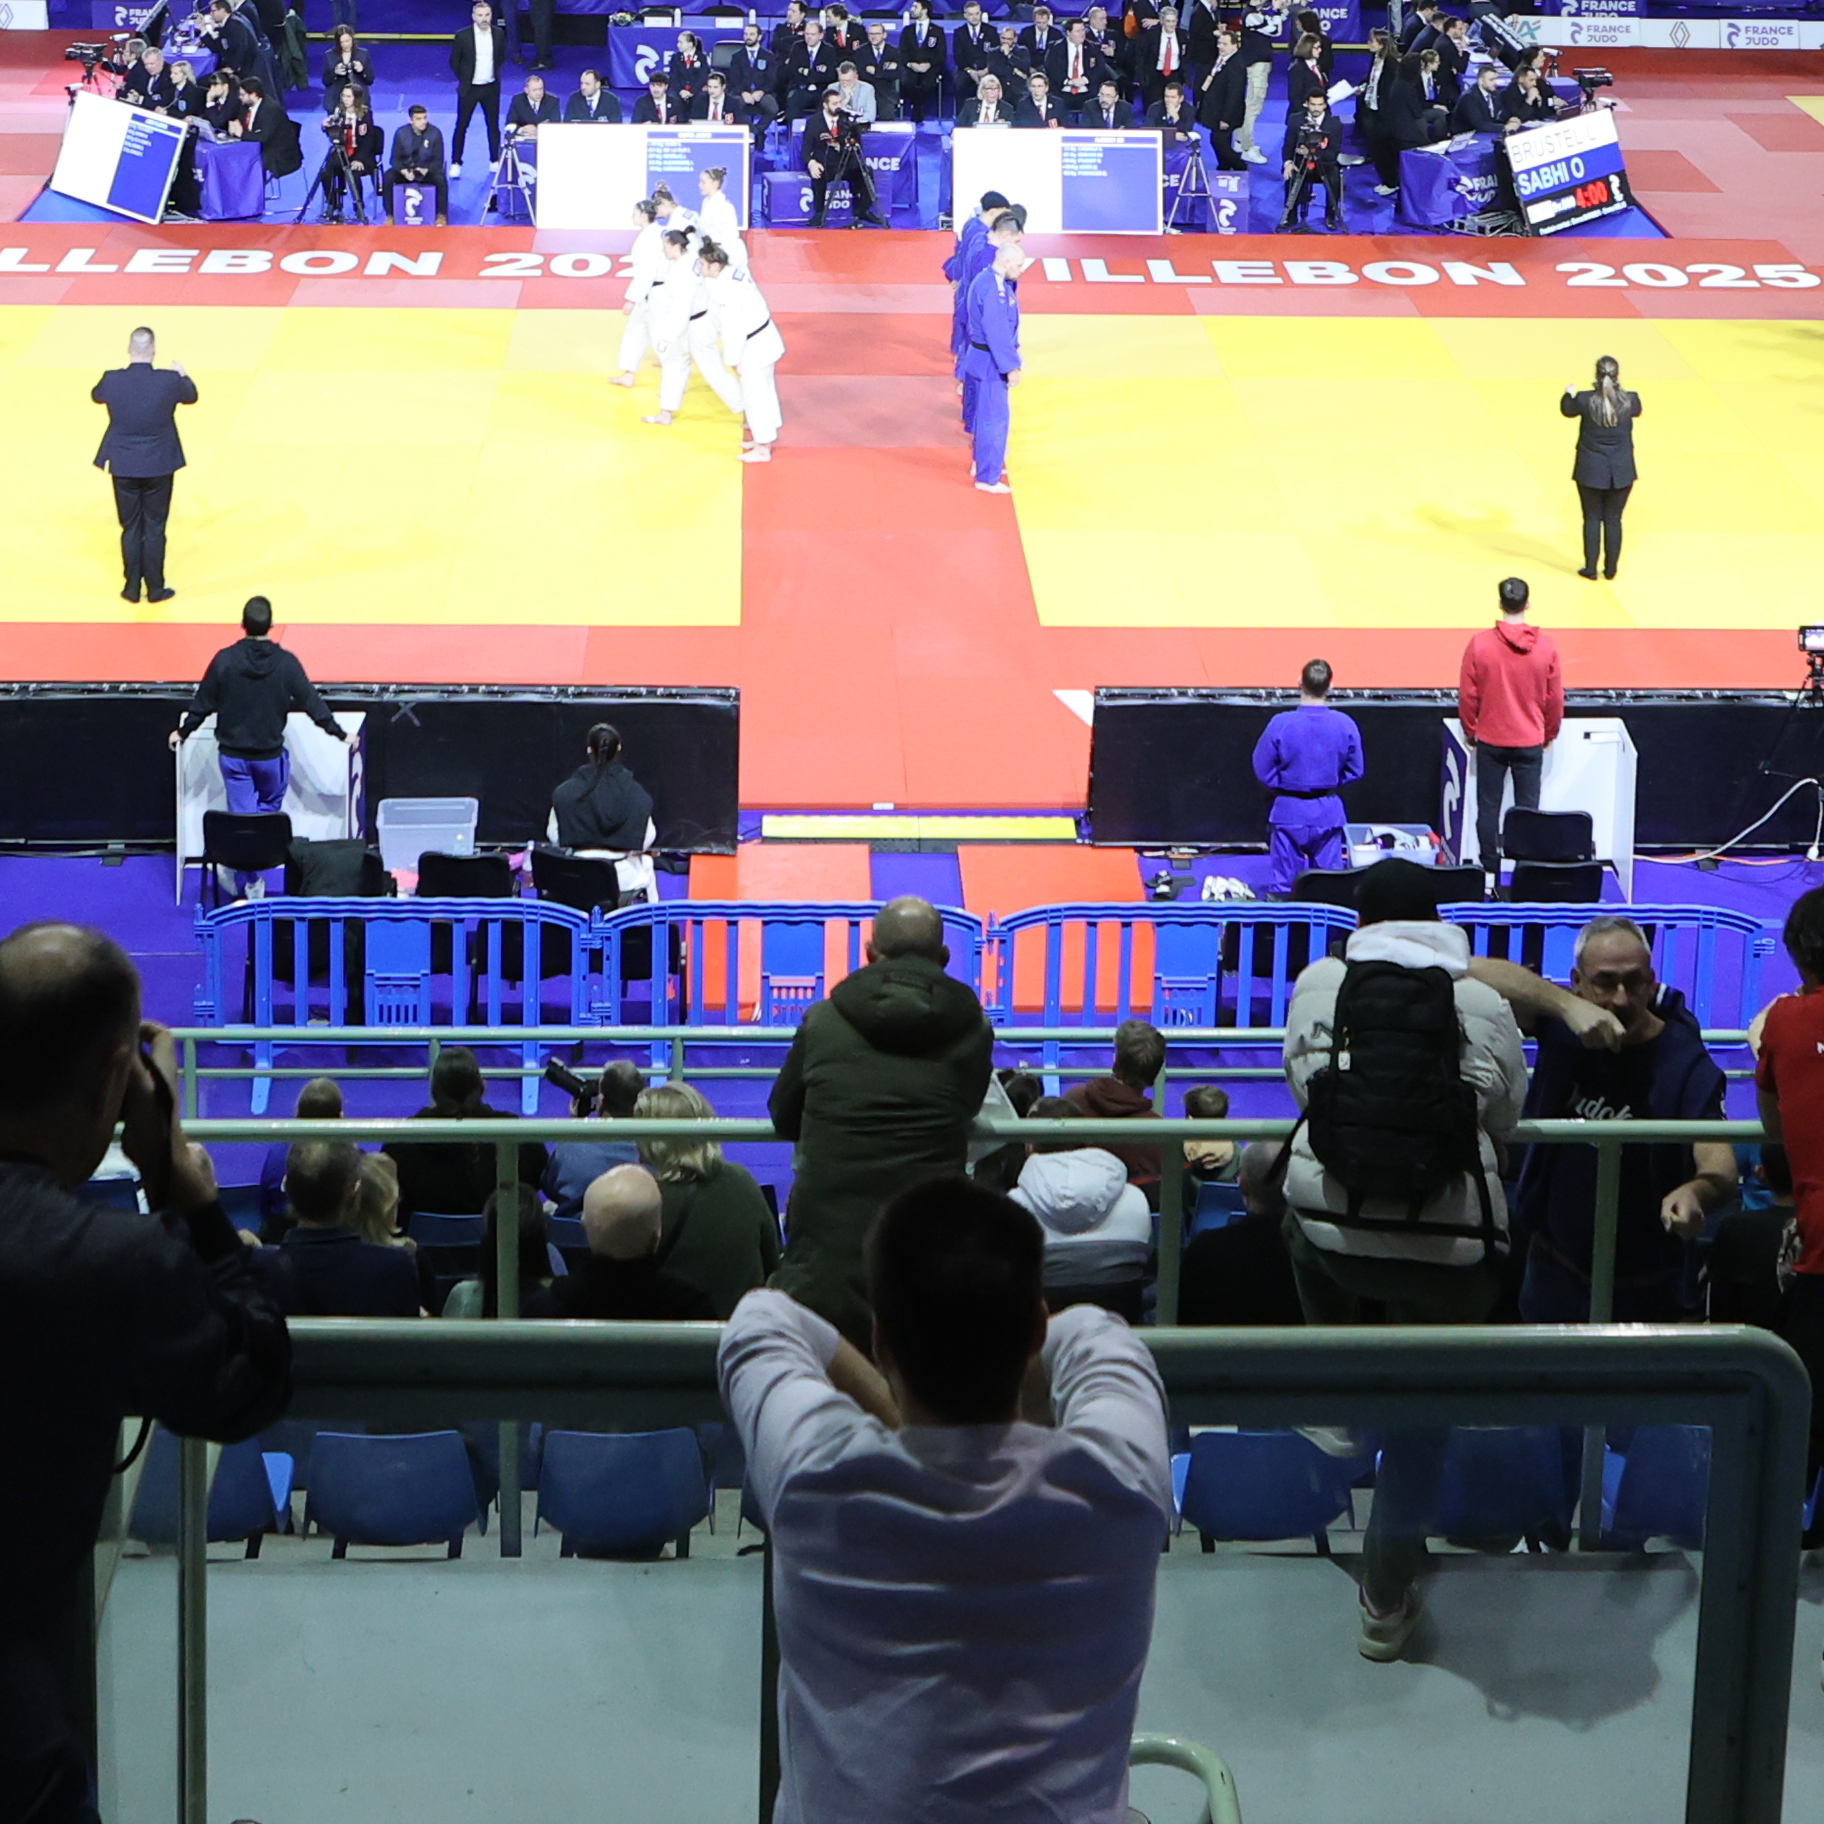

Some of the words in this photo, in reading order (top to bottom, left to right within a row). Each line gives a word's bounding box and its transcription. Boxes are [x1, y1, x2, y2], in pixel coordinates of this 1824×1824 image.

[1580, 0, 1637, 13] FRANCE
[1587, 24, 1632, 35] FRANCE
[1744, 26, 1795, 37] FRANCE
[1587, 34, 1619, 45] JUDO
[1745, 37, 1780, 48] JUDO
[1518, 161, 1571, 196] SABHI
[1575, 180, 1609, 209] 4:00
[1555, 262, 1822, 291] 2025
